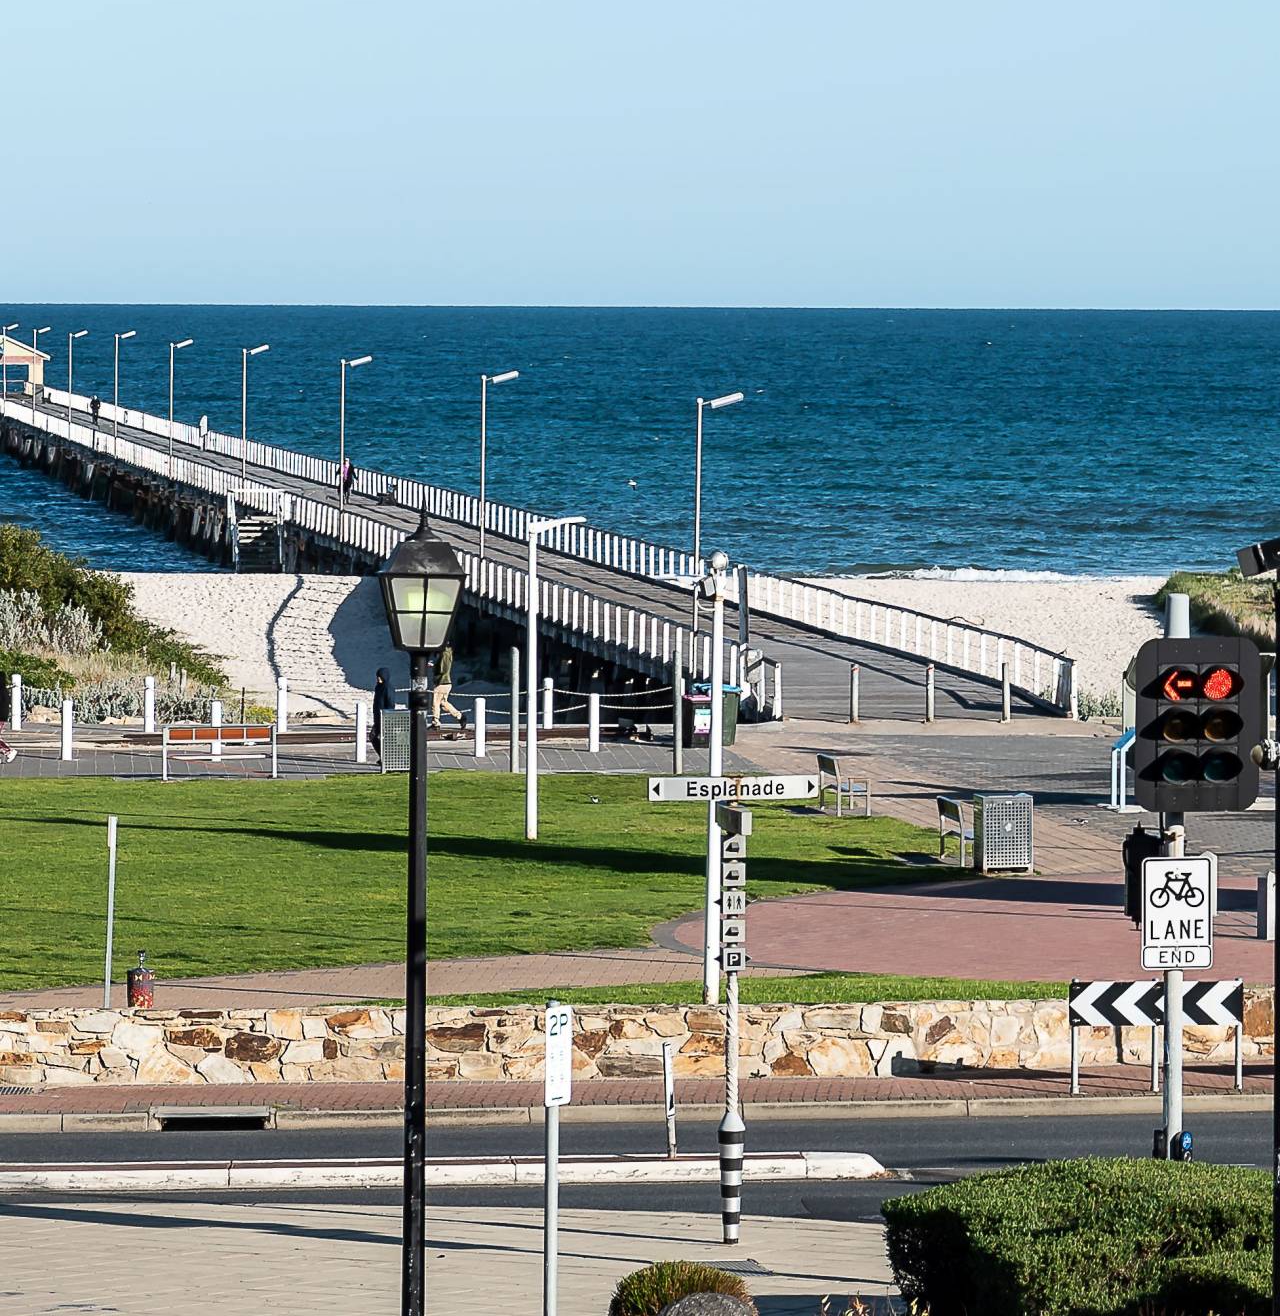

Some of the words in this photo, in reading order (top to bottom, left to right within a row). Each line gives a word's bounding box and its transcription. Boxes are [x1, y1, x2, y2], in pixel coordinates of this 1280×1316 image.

[686, 780, 785, 800] Esplanade
[1150, 919, 1204, 940] LANE
[729, 954, 739, 966] P
[1159, 950, 1195, 964] END
[549, 1013, 569, 1036] 2P
